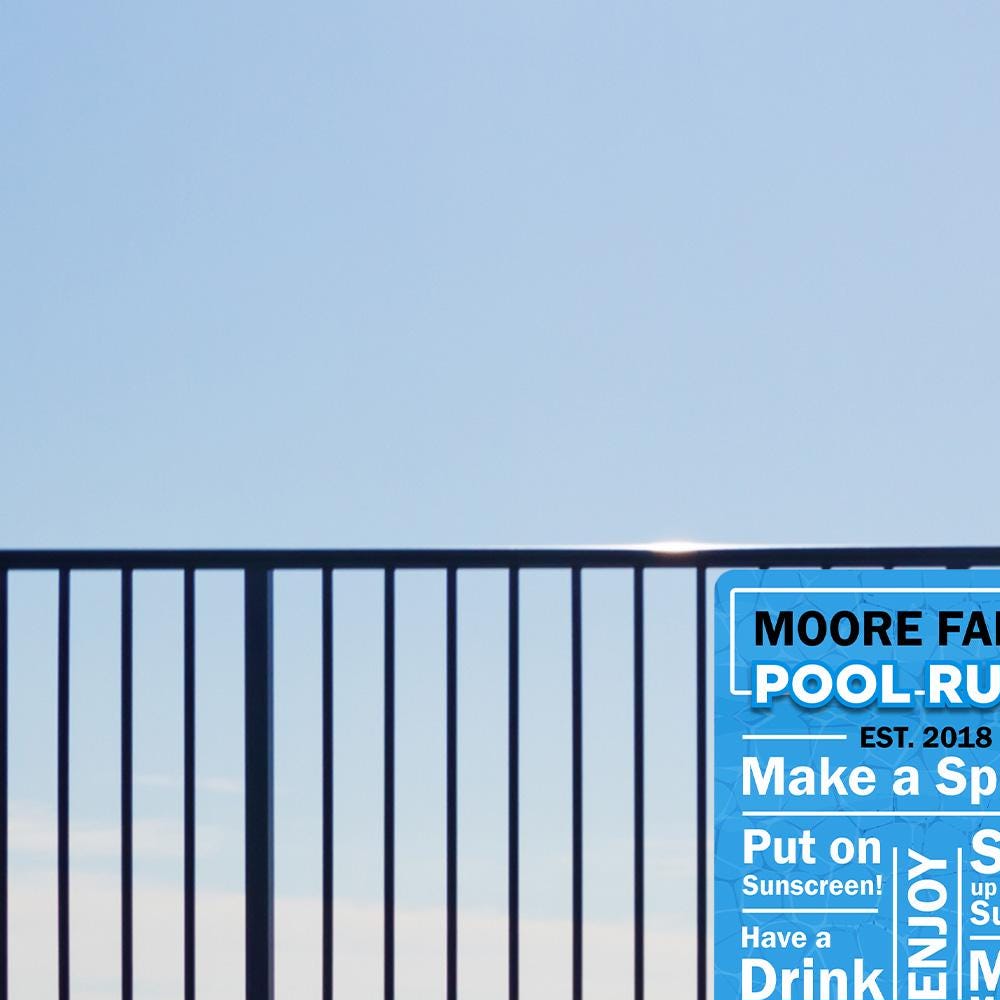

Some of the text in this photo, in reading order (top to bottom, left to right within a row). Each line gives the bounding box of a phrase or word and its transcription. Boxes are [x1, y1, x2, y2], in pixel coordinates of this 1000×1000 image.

[756, 610, 922, 646] MOORE
[756, 664, 910, 704] POOL
[860, 726, 992, 748] EST. 2018
[742, 756, 876, 796] Make
[892, 765, 920, 796] a
[743, 828, 881, 865] Put on
[742, 874, 883, 896] Sunscreen!
[971, 882, 997, 900] up
[741, 926, 831, 949] Have a
[907, 848, 948, 1000] ENJOY
[741, 957, 885, 1000] Drink
